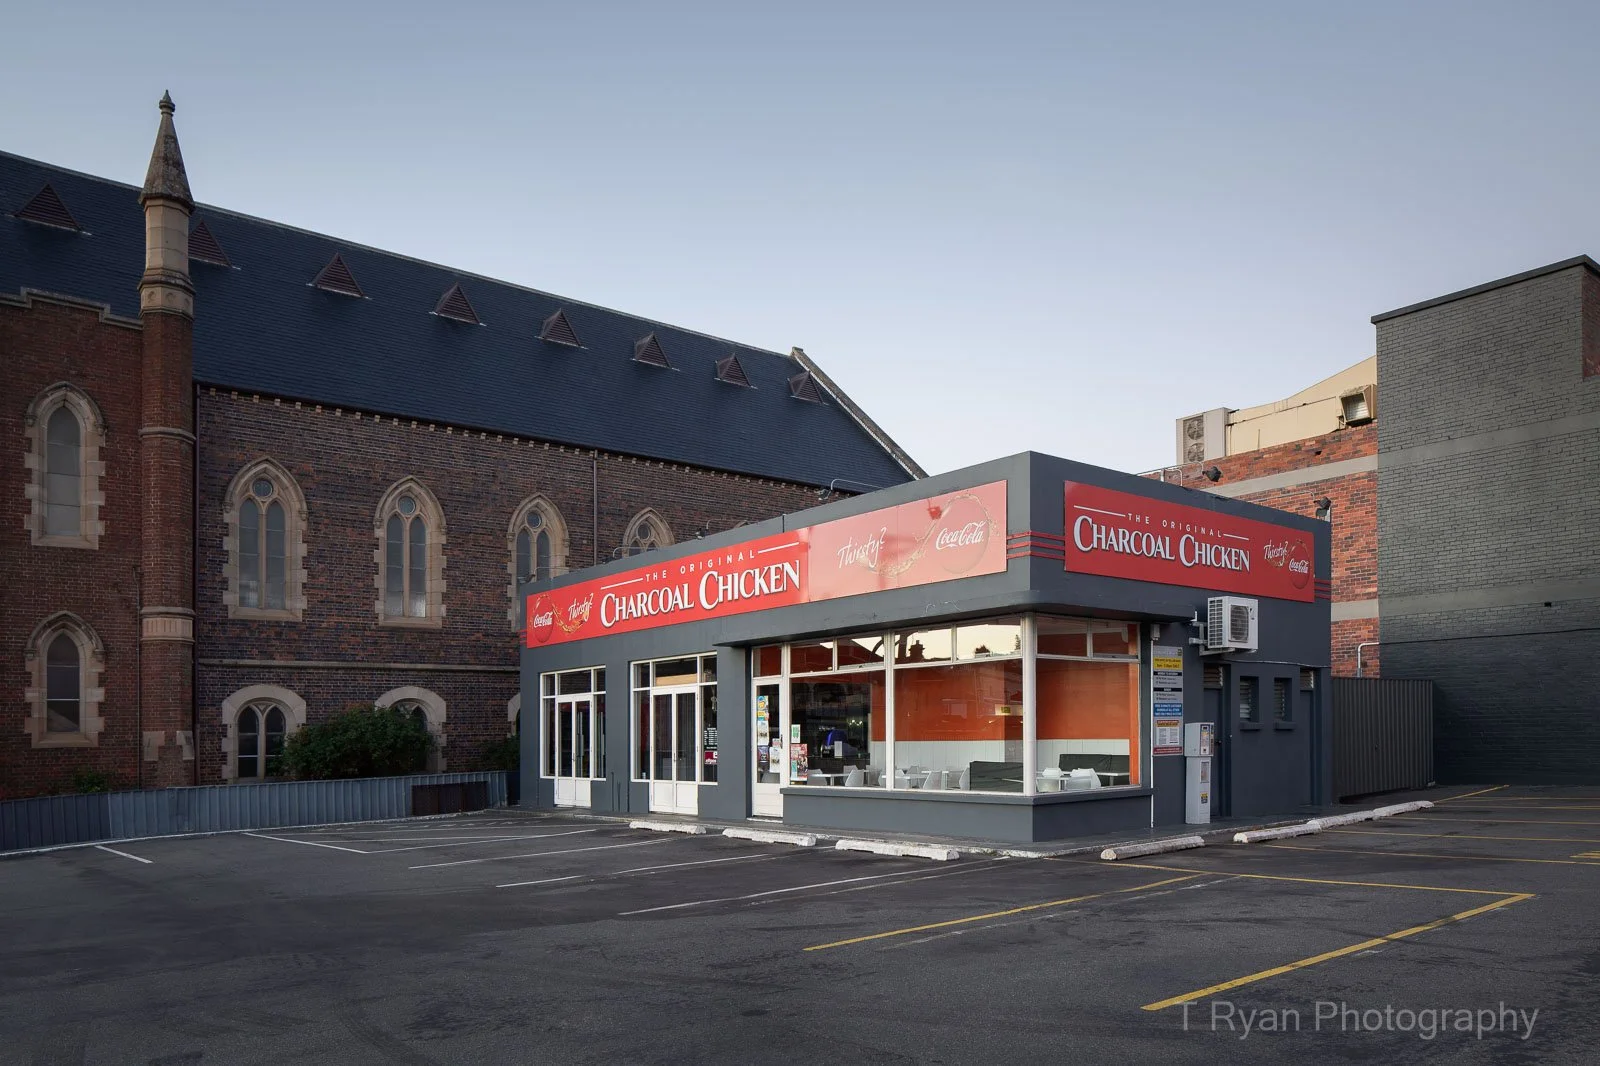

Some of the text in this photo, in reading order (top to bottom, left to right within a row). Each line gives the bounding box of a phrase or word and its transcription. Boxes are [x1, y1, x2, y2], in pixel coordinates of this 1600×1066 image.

[1127, 513, 1223, 538] THE ORIGINAL
[837, 526, 888, 569] Thirsty?
[1073, 515, 1250, 573] CHARCOAL CHICKEN
[1263, 539, 1288, 567] Thirsty?
[645, 549, 755, 583] THE ORIGINAL
[567, 592, 595, 623] Thirsty?
[600, 559, 801, 629] CHARCOAL CHICKEN
